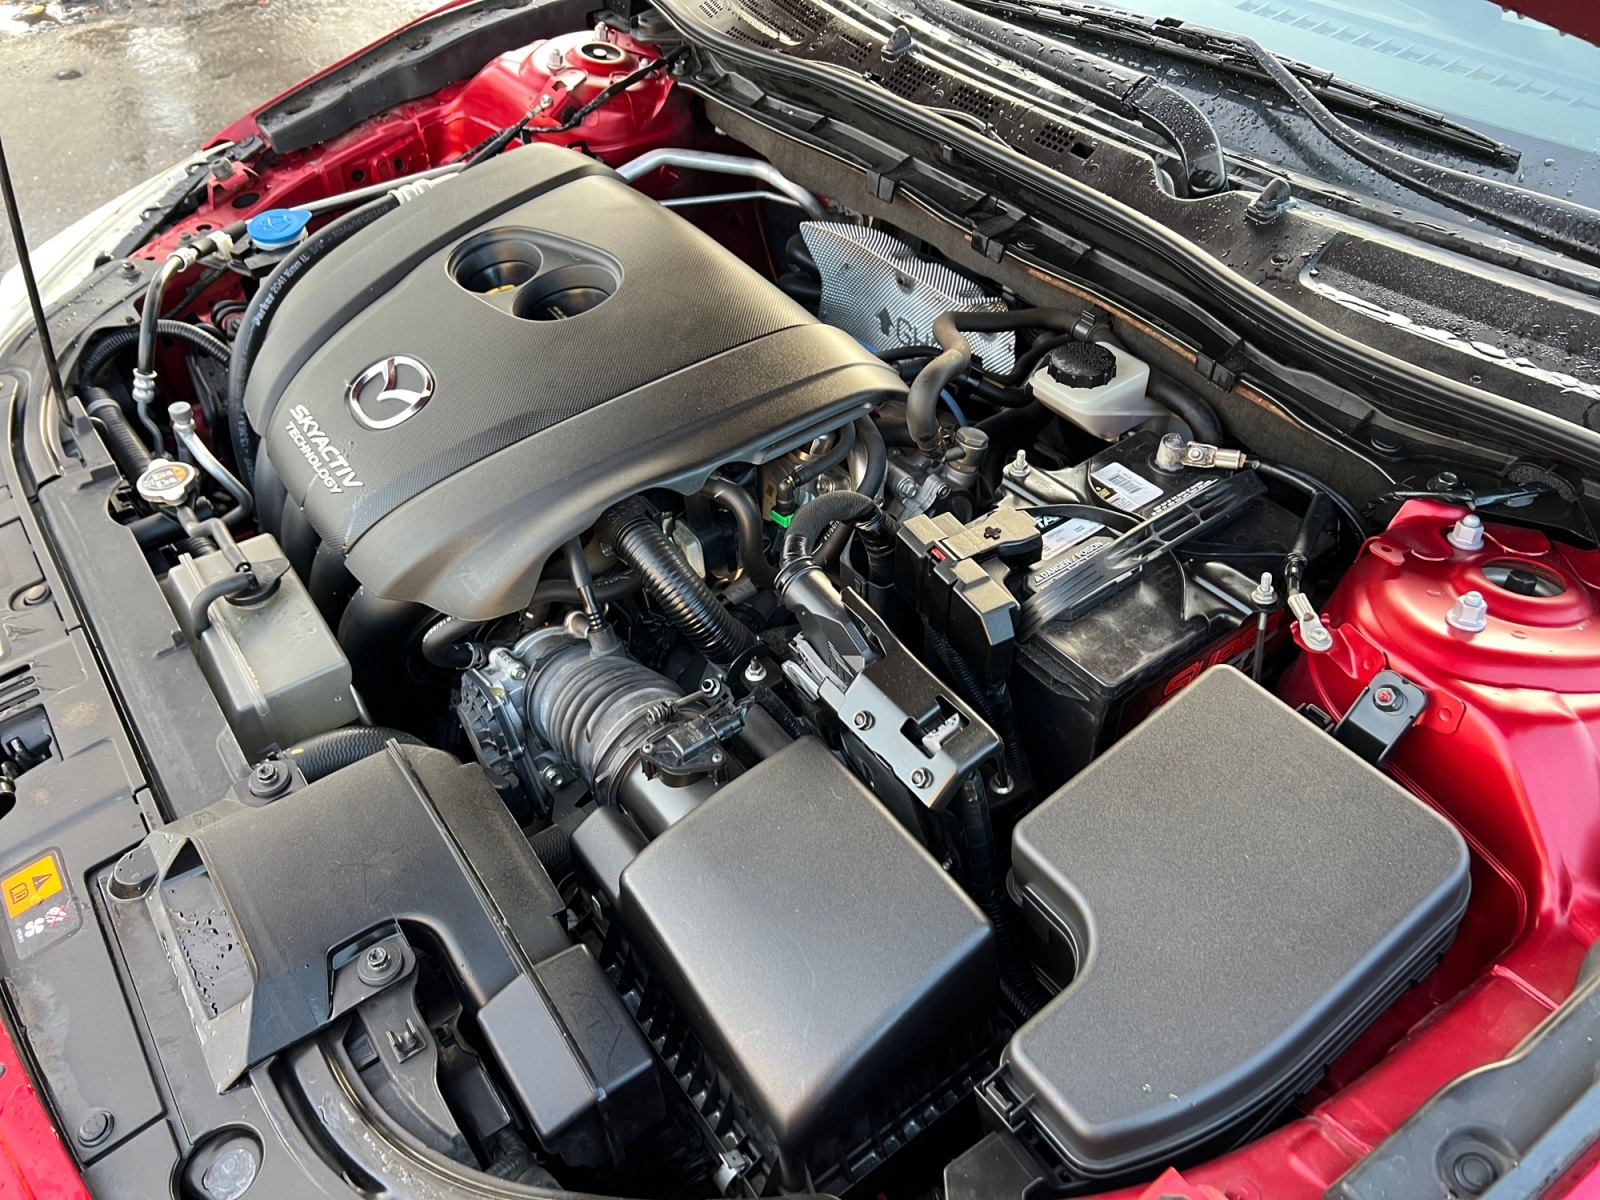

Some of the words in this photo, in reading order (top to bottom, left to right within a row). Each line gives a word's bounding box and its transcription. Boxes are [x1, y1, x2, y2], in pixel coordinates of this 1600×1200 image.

[285, 420, 344, 494] TECHNOLOGY
[289, 404, 364, 487] SKYACTIV
[1040, 558, 1073, 578] DANGER
[1074, 540, 1104, 558] POISON
